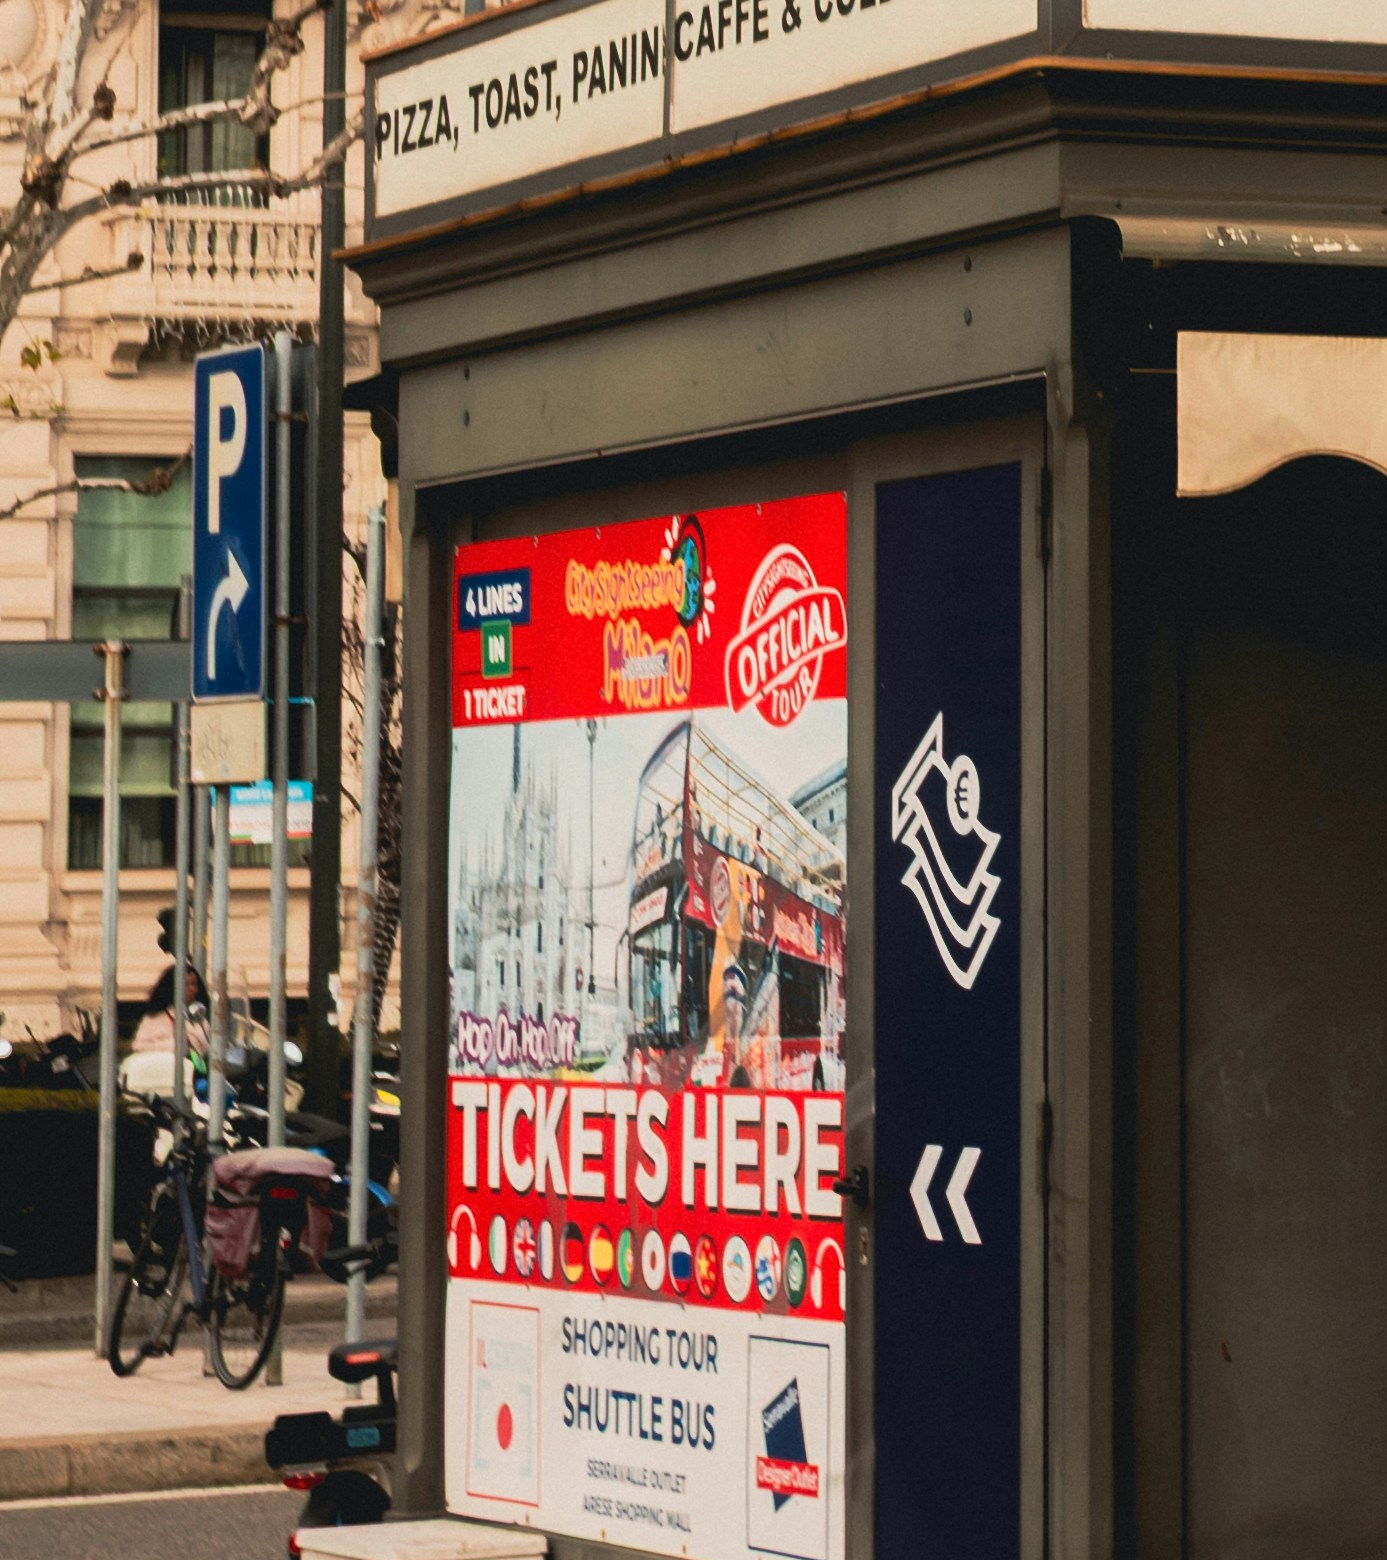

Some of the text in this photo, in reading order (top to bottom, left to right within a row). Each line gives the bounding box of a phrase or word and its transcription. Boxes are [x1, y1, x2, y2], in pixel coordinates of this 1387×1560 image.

[375, 102, 461, 162] PIZZA,
[468, 60, 562, 134] TOAST,
[207, 371, 248, 535] P
[465, 583, 523, 617] 4 LINES
[488, 634, 505, 664] IN
[738, 596, 840, 698] OFFICIAL
[464, 686, 526, 719] 1 TICKET
[770, 666, 813, 722] TOUR
[458, 1010, 494, 1072] Hop
[495, 1007, 519, 1067] On
[452, 1082, 843, 1218] TICKETS HERE
[562, 1317, 661, 1367] SHOPPING
[667, 1329, 718, 1374] TOUR
[563, 1384, 715, 1451] SHUTTLE BUS
[587, 1459, 647, 1484] SERRAVALLE
[616, 1501, 663, 1527] SHOPPING
